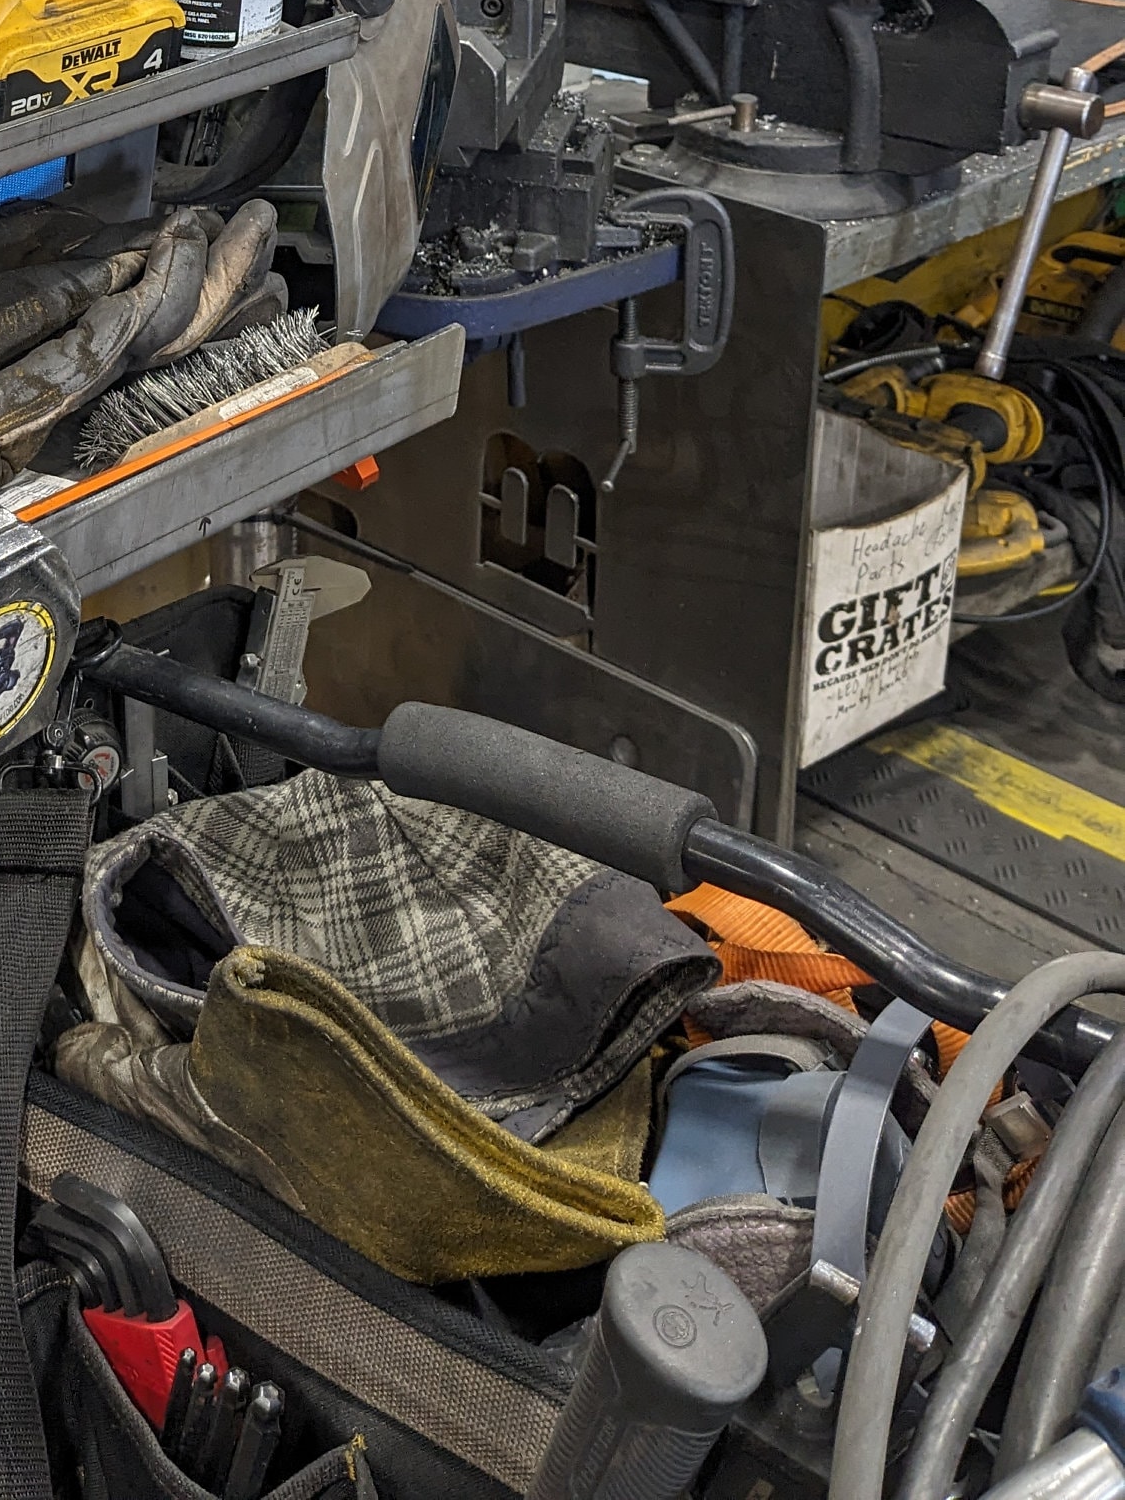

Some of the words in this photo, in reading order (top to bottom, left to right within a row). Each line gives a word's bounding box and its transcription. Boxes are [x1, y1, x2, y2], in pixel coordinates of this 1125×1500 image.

[143, 48, 163, 70] 4
[814, 585, 953, 677] CRATES
[817, 562, 942, 644] GIFT
[813, 669, 857, 692] BECAUSE
[859, 662, 881, 676] MEN
